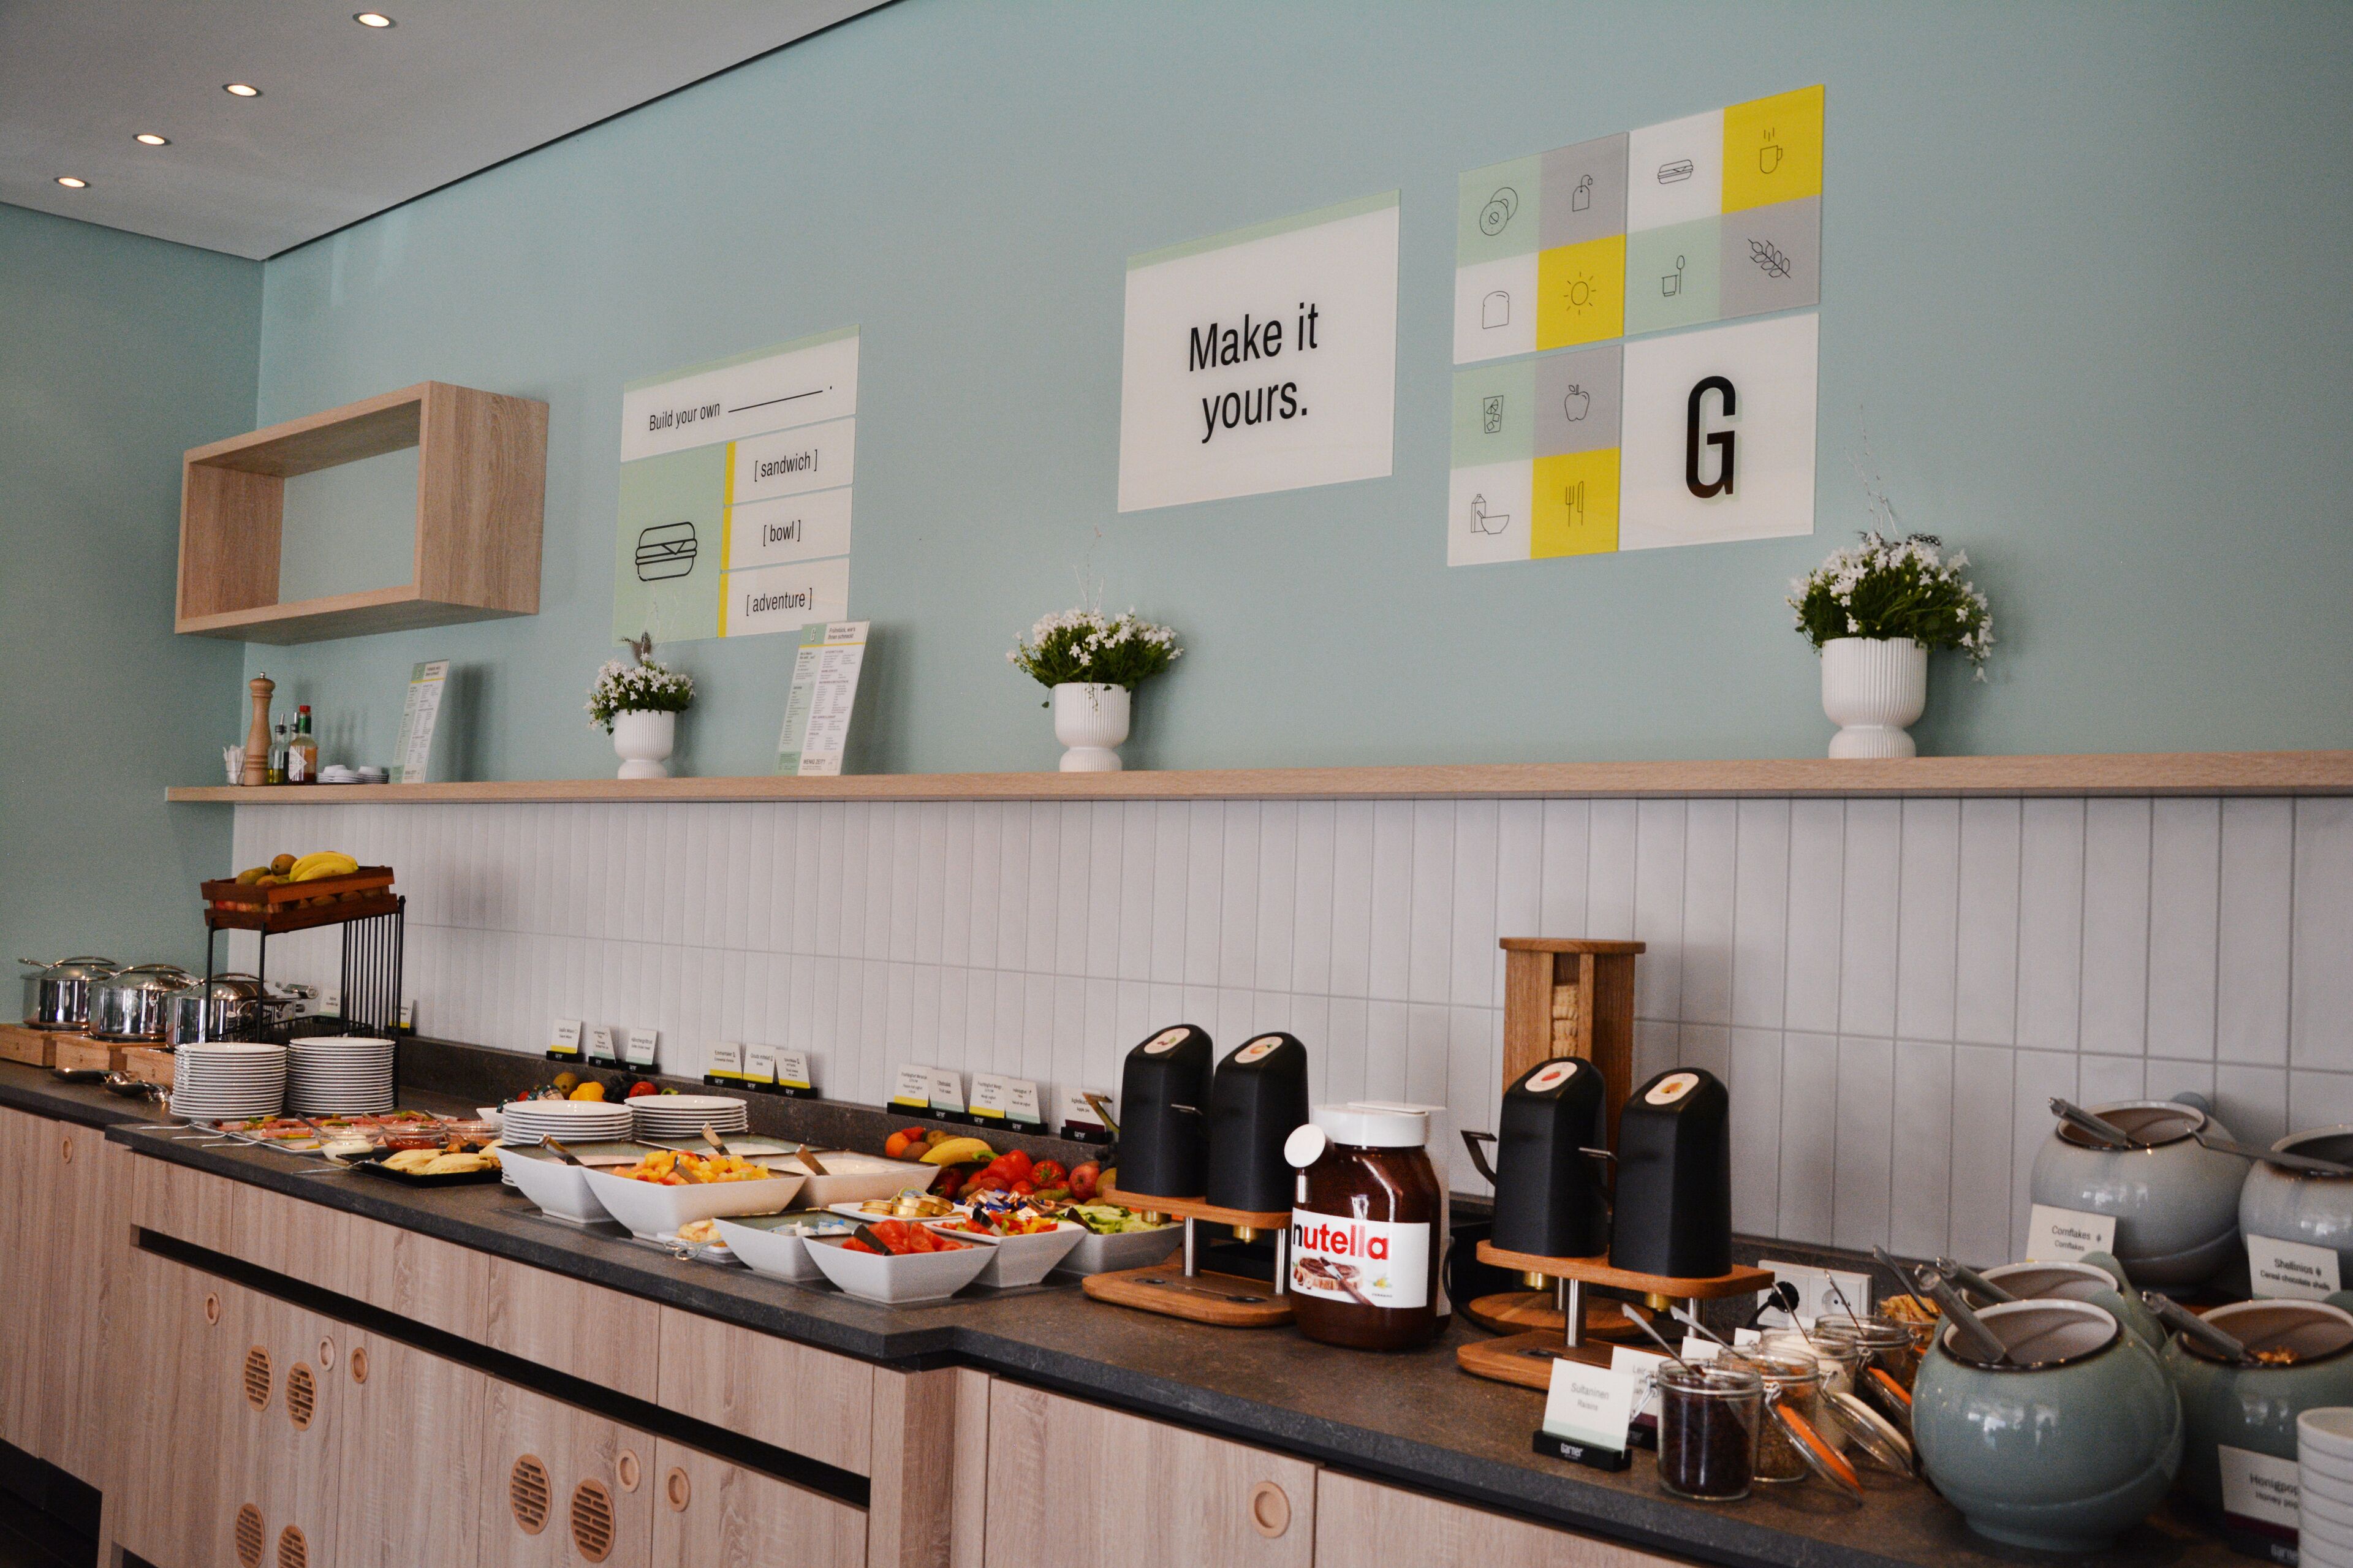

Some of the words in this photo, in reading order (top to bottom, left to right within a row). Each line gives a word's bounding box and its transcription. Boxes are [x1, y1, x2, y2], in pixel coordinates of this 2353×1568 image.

[1189, 313, 1283, 372] Make
[1297, 302, 1319, 351] it
[649, 411, 673, 431] Build
[676, 407, 697, 428] your
[700, 403, 721, 420] own
[1201, 382, 1308, 444] yours.
[1686, 375, 1737, 499] G
[760, 452, 811, 477] sandwich
[770, 521, 794, 542] bowl
[752, 591, 805, 612] adventure
[1293, 1222, 1389, 1260] nutella
[2052, 1225, 2091, 1240] Cornflakes
[1571, 1382, 1609, 1400] Sultaninen
[2249, 1473, 2298, 1496] Honigpop
